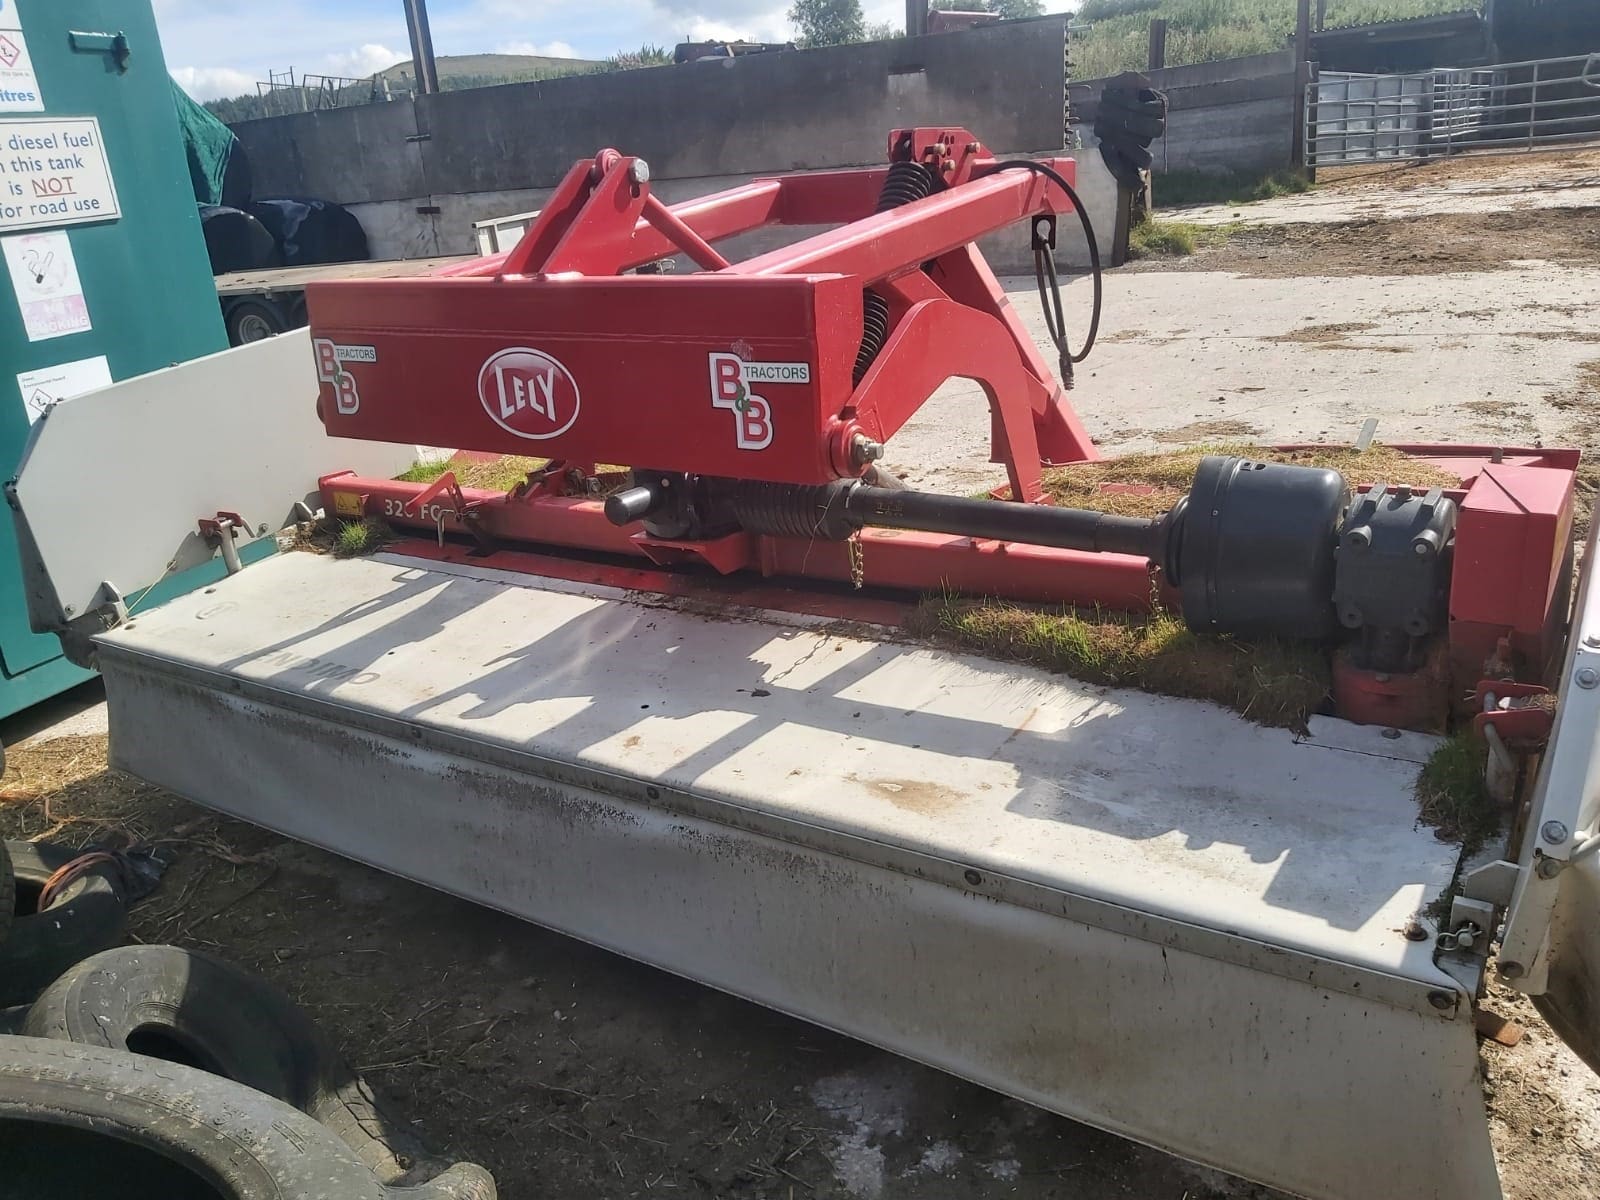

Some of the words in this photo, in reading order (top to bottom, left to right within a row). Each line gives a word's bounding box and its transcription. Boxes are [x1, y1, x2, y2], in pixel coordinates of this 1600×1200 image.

[8, 133, 59, 151] diesel
[63, 131, 94, 148] fuel
[11, 156, 43, 173] this
[48, 153, 85, 171] tank
[8, 180, 24, 196] is
[31, 176, 77, 197] NOT
[30, 197, 68, 216] road
[74, 198, 100, 212] use
[336, 348, 375, 360] TRACTORS
[743, 366, 808, 380] TRACTORS
[494, 364, 556, 423] LELY
